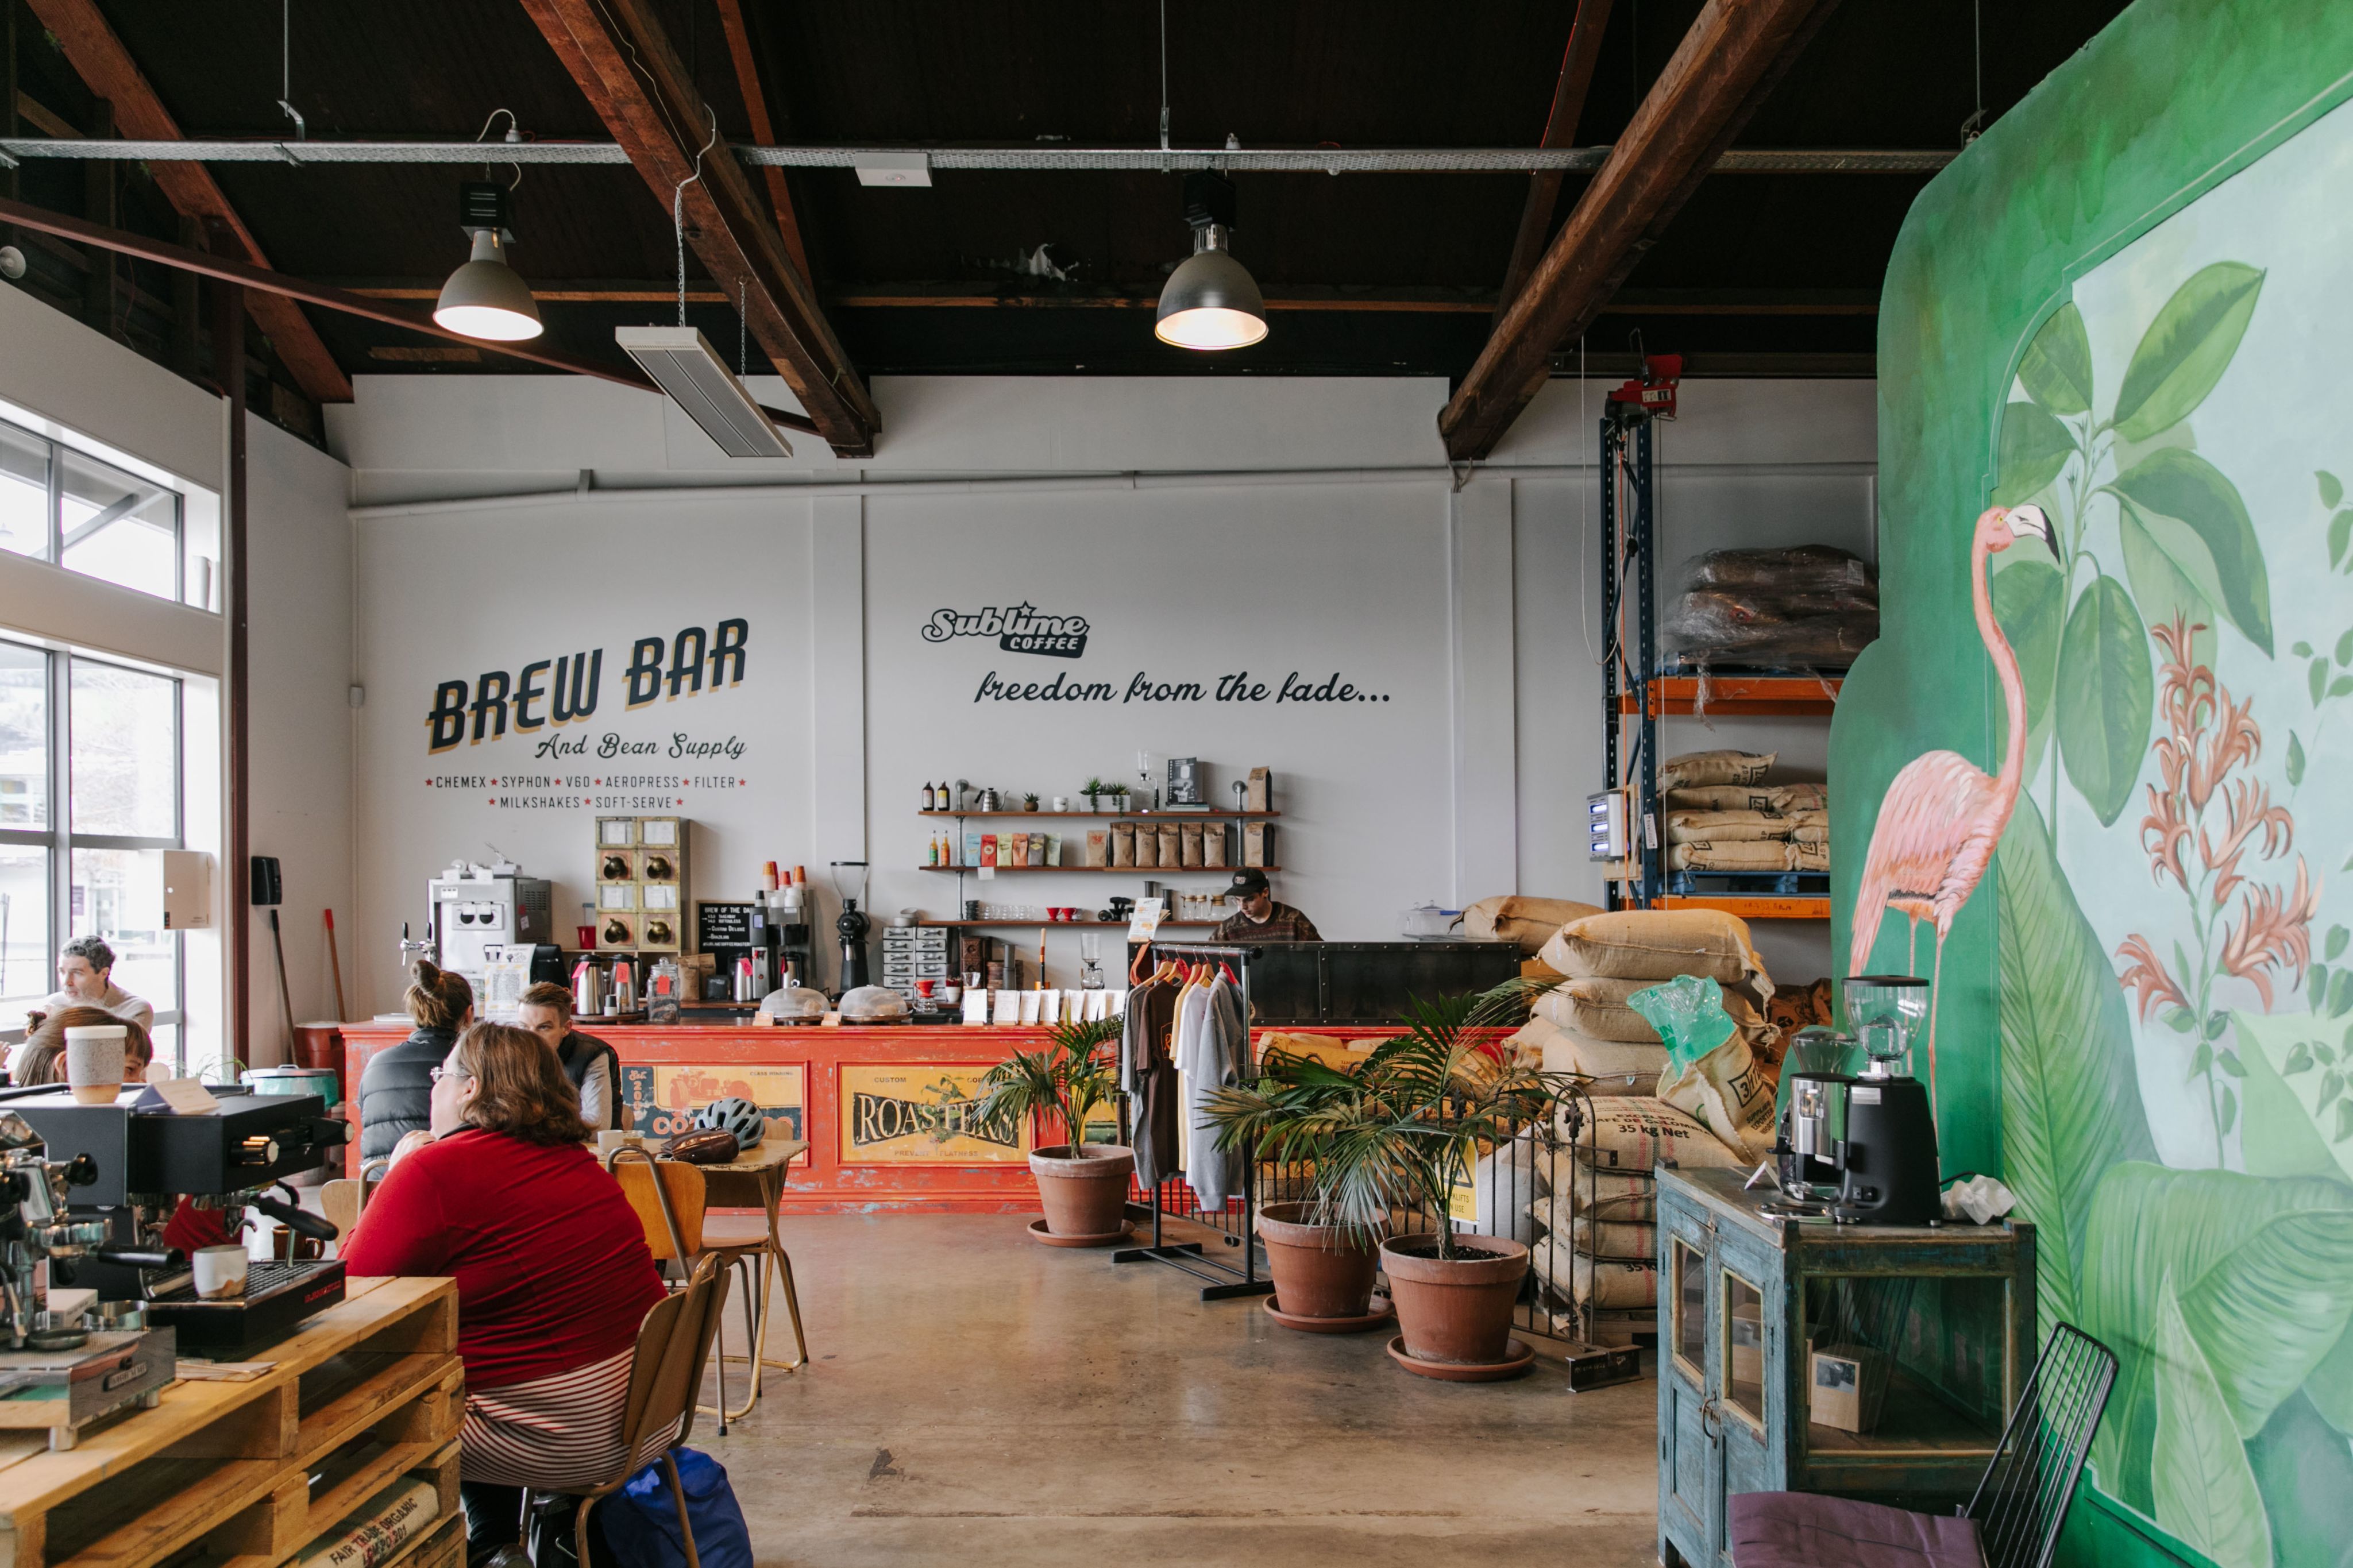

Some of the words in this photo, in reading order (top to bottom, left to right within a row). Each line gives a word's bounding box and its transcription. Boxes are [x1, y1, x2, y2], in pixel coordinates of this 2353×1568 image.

[921, 601, 1090, 643] Sublime
[1009, 636, 1079, 651] COFFEE
[426, 648, 603, 755] BREW
[622, 618, 749, 711] BAR
[974, 670, 1117, 704] freedom
[1123, 670, 1207, 704] from
[1276, 671, 1390, 705] fade...
[534, 732, 589, 760] And
[596, 732, 660, 758] Bean
[668, 731, 748, 759] Supply
[435, 775, 487, 789] CHEMEX
[501, 775, 551, 788] SYPHON
[566, 775, 591, 788] V60
[605, 775, 679, 789] AEROPRESS
[694, 775, 735, 789] FILTER
[500, 795, 580, 809] MILKSHAKES
[595, 795, 672, 809] SOFT-SERVE
[1618, 1124, 1637, 1134] 35
[1641, 1124, 1659, 1138] kg
[1662, 1126, 1690, 1139] Net
[1455, 1204, 1465, 1213] USE
[1624, 1263, 1643, 1272] 35
[330, 1544, 357, 1566] FAIR
[352, 1526, 383, 1548] TRADE
[379, 1497, 418, 1530] ORGANIC
